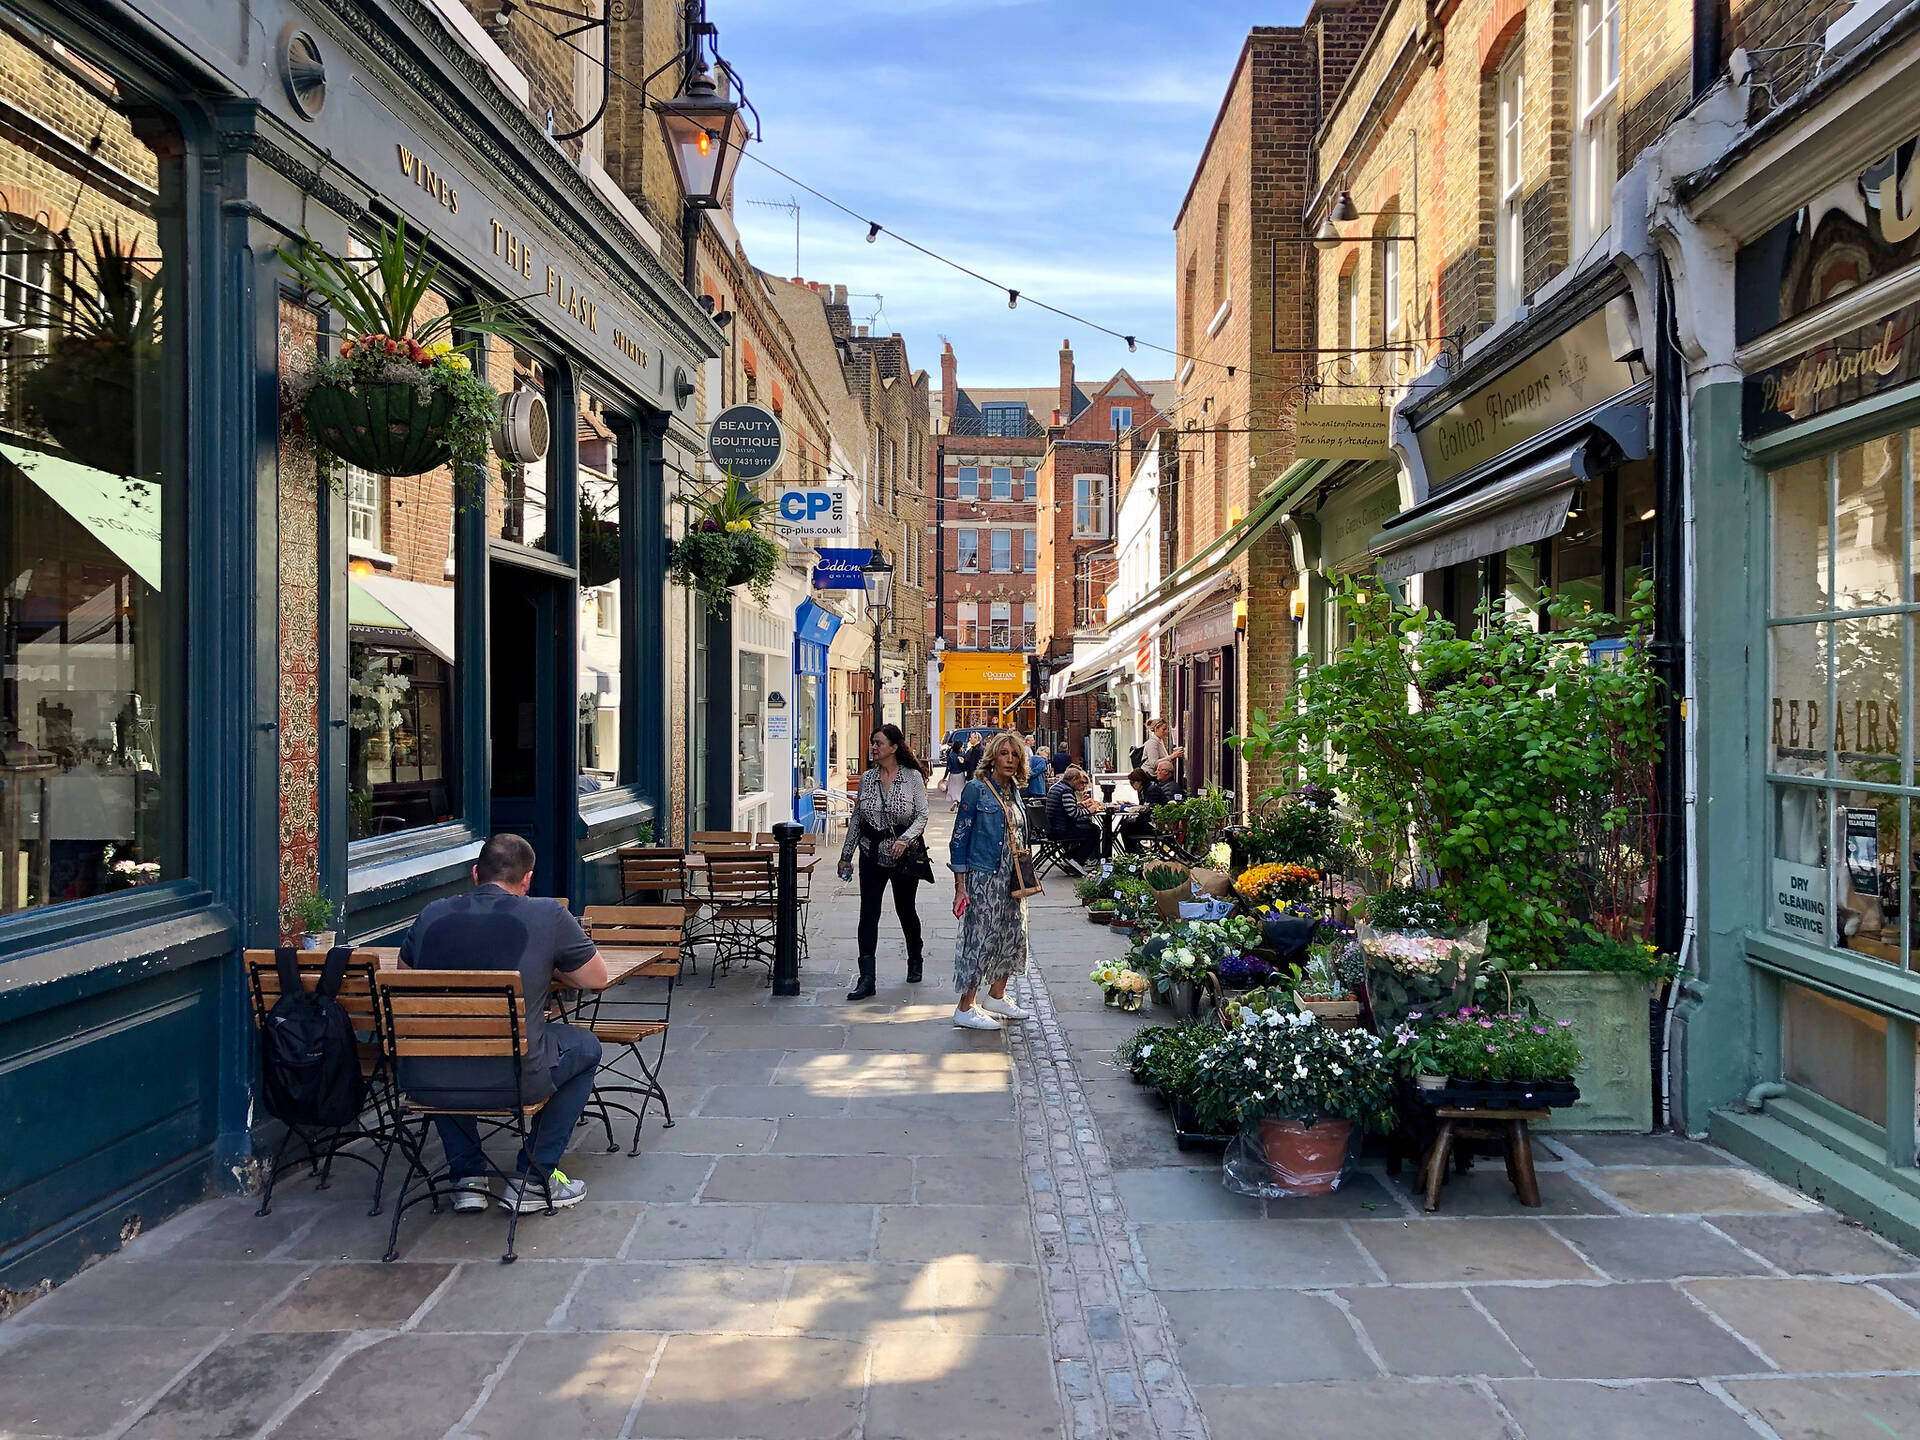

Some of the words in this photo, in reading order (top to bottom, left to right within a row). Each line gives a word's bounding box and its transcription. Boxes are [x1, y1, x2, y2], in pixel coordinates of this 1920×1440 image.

[398, 144, 459, 215] WINES
[490, 218, 532, 281] THE
[546, 265, 599, 335] FLASK
[613, 328, 649, 370] SPIRITS
[1762, 320, 1896, 414] Professional
[719, 421, 772, 431] BEAUTY
[1300, 420, 1386, 430] www.galtonflowers.com
[1438, 418, 1485, 461] Galton
[1486, 374, 1551, 434] Flowers
[712, 437, 780, 447] BOUTIQUE
[1300, 436, 1315, 444] The
[1344, 436, 1386, 448] Academy
[719, 457, 733, 465] 020
[754, 458, 771, 466] 9111
[780, 492, 832, 521] CP
[832, 492, 843, 521] PLUS
[781, 526, 842, 536] cp-plus.co.uk
[1772, 698, 1898, 753] REPAIRS
[1791, 876, 1809, 891] DRY
[1778, 892, 1825, 915] CLEANING
[1784, 912, 1824, 934] SERVICE
